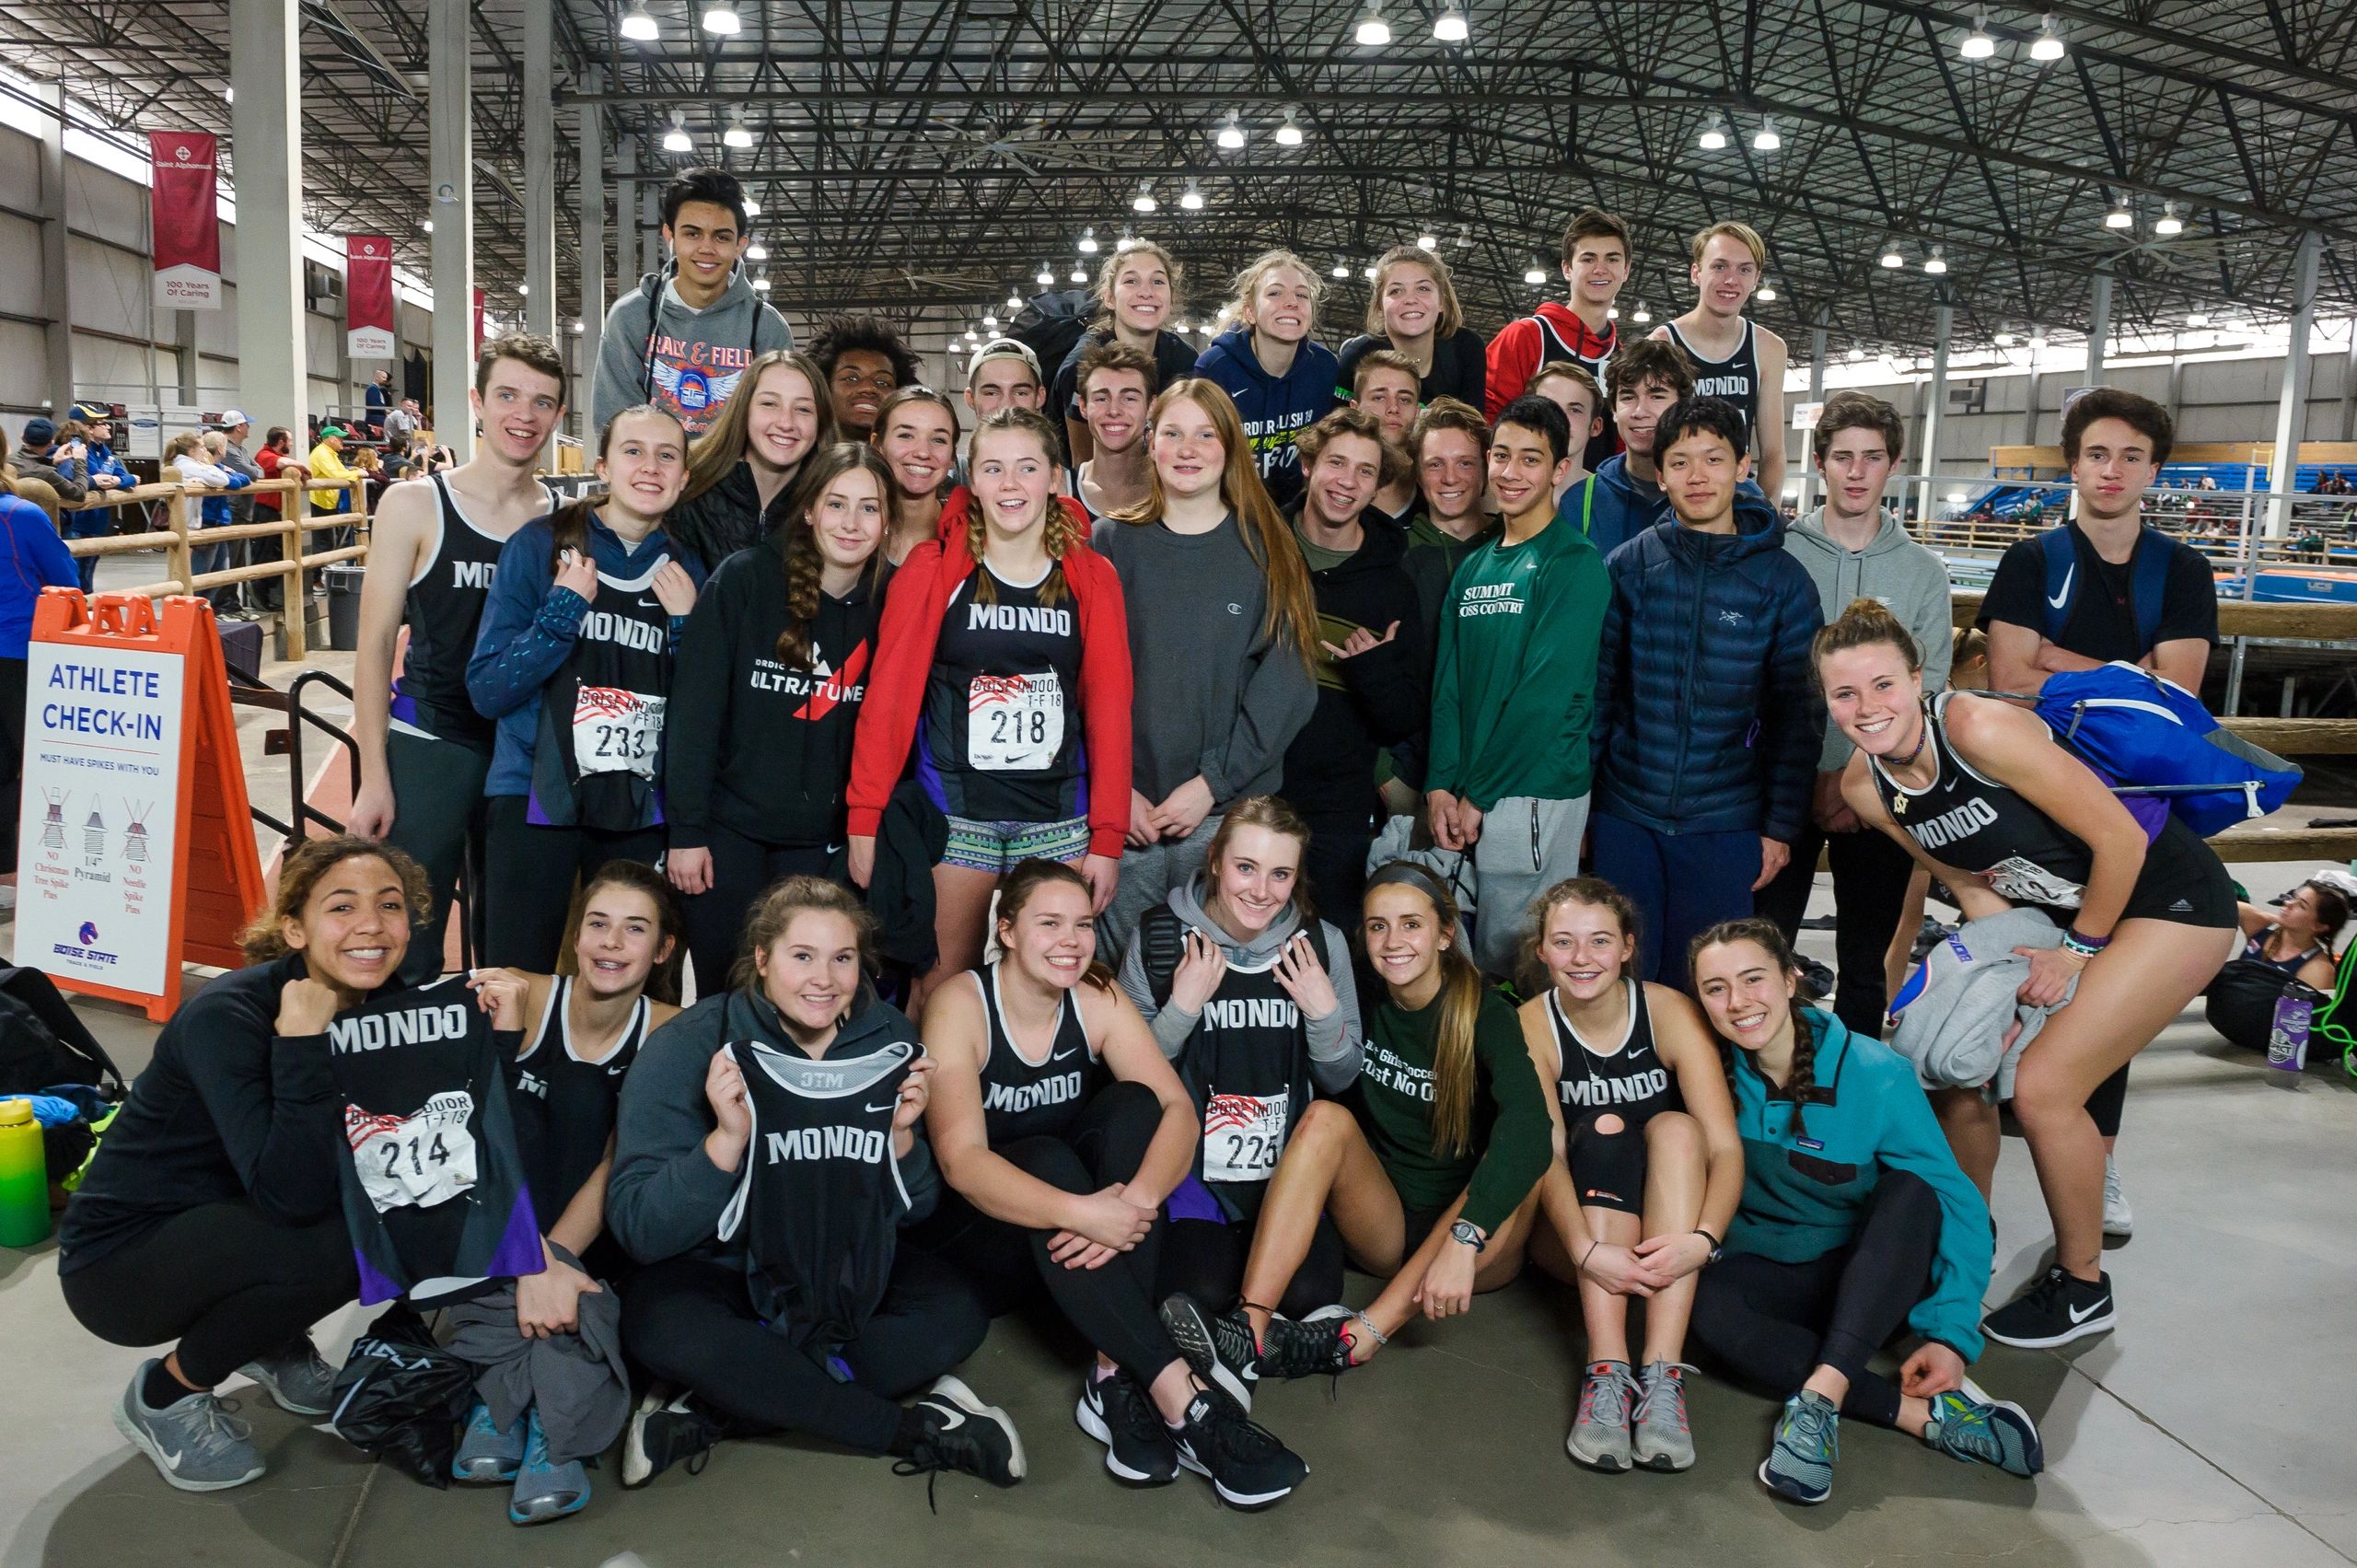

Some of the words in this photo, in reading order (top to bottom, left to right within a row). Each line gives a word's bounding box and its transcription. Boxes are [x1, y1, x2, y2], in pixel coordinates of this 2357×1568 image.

[166, 280, 182, 288] 100
[186, 281, 209, 289] Years
[180, 289, 209, 298] Caring
[691, 341, 709, 366] &
[711, 345, 753, 368] FIELD
[1692, 376, 1749, 397] MONDO
[1305, 409, 1314, 424] 19
[452, 561, 498, 589] MO
[967, 603, 1071, 636] MONDO
[1458, 605, 1479, 617] OSS
[579, 611, 664, 655] MONDO
[755, 658, 785, 670] ORDIC
[49, 664, 159, 698] ATHLETE
[973, 677, 1011, 692] BOISE
[580, 691, 621, 709] BOISE
[1051, 693, 1061, 707] 18
[43, 703, 162, 740] CHECK-IN
[991, 710, 1045, 744] 218
[596, 725, 644, 760] 233
[40, 753, 61, 763] MUST
[64, 755, 85, 767] HAVE
[87, 759, 114, 771] SPIKES
[117, 762, 139, 773] WITH
[142, 765, 159, 775] YOU
[1905, 796, 1998, 849] MONDO
[47, 851, 58, 861] NO
[35, 862, 69, 876] Christmas
[75, 866, 110, 882] Pyramid
[129, 865, 142, 874] NO
[35, 875, 49, 885] Tree
[51, 878, 69, 889] Spike
[43, 889, 58, 900] Pins
[124, 890, 144, 901] Spike
[125, 904, 140, 914] Pins
[53, 944, 85, 958] BOISE
[87, 950, 118, 964] STATE
[1203, 999, 1298, 1031] MONDO
[325, 1004, 467, 1056] MONDO
[1379, 1049, 1403, 1069] Girls
[1361, 1057, 1391, 1086] rust
[1393, 1071, 1417, 1097] No
[1421, 1083, 1437, 1103] O
[1560, 1069, 1667, 1106] MONDO
[982, 1071, 1082, 1113] MONDO
[1210, 1099, 1247, 1117] BOISE
[1253, 1099, 1288, 1118] INDOO
[1263, 1117, 1281, 1132] T-F
[765, 1125, 885, 1164] MONDO
[1225, 1134, 1278, 1170] 225
[380, 1132, 451, 1179] 214
